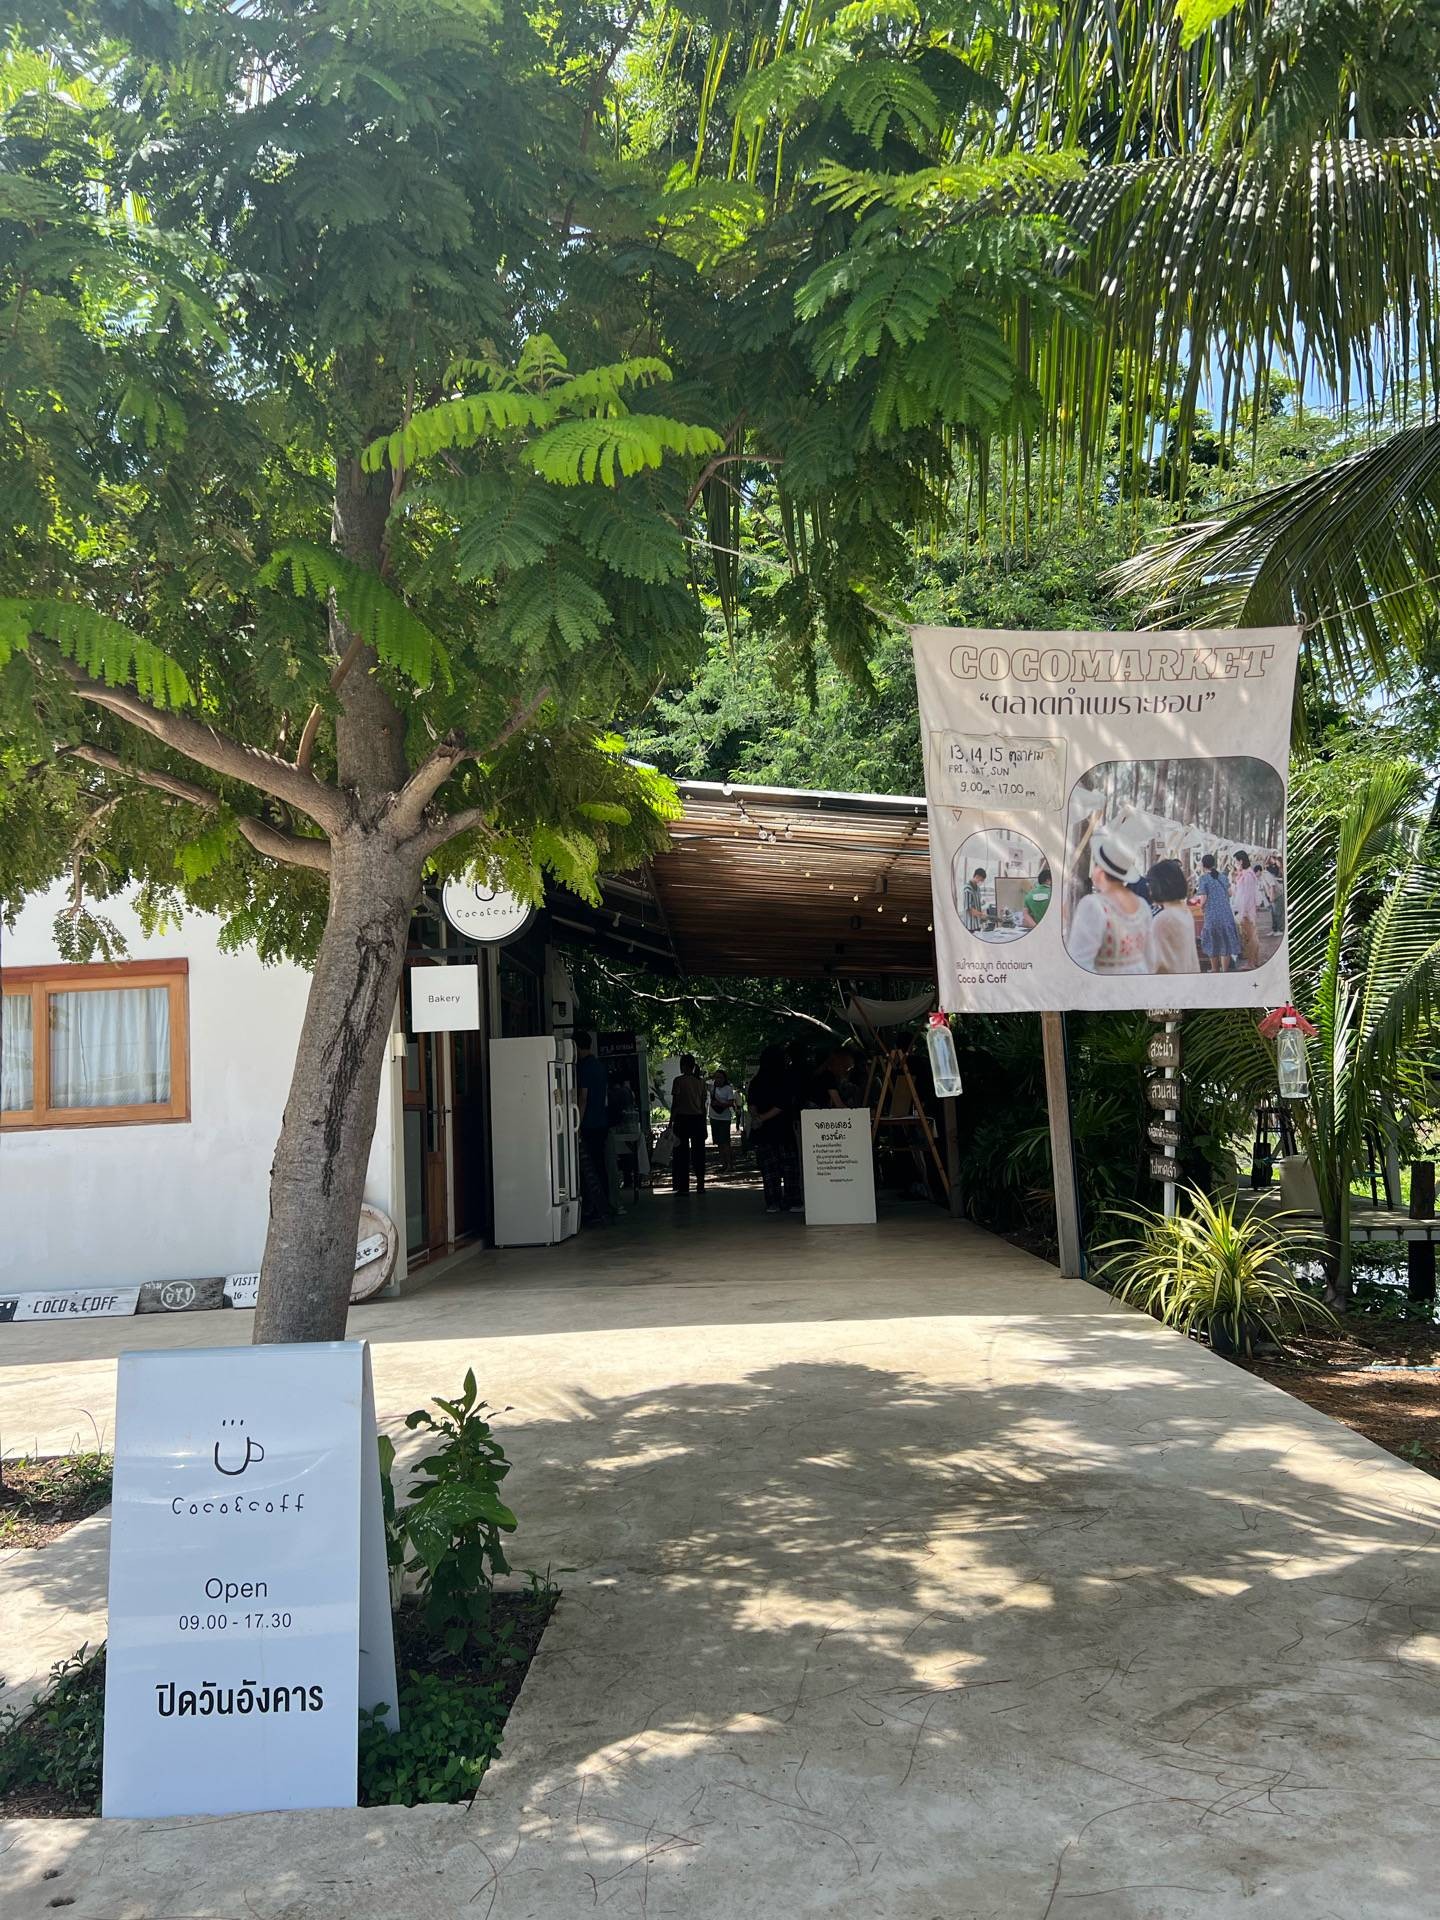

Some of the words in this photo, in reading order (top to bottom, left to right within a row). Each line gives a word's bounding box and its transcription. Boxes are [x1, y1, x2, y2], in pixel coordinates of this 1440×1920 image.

[950, 645, 1274, 682] COCOMARKET
[991, 766, 1010, 776] SUN
[957, 974, 977, 984] Coco
[978, 974, 985, 984] &
[986, 974, 1008, 984] Coff
[428, 995, 460, 1003] Bakery
[232, 1276, 259, 1287] VISIT
[33, 1299, 69, 1314] COCO
[69, 1302, 78, 1313] &
[81, 1296, 119, 1312] COFF
[171, 1493, 306, 1515] Coco&coff
[204, 1577, 269, 1604] Open
[178, 1614, 228, 1631] 09.00
[243, 1613, 293, 1630] 17.30
[155, 1678, 324, 1717] ปิดวันอังคาร
